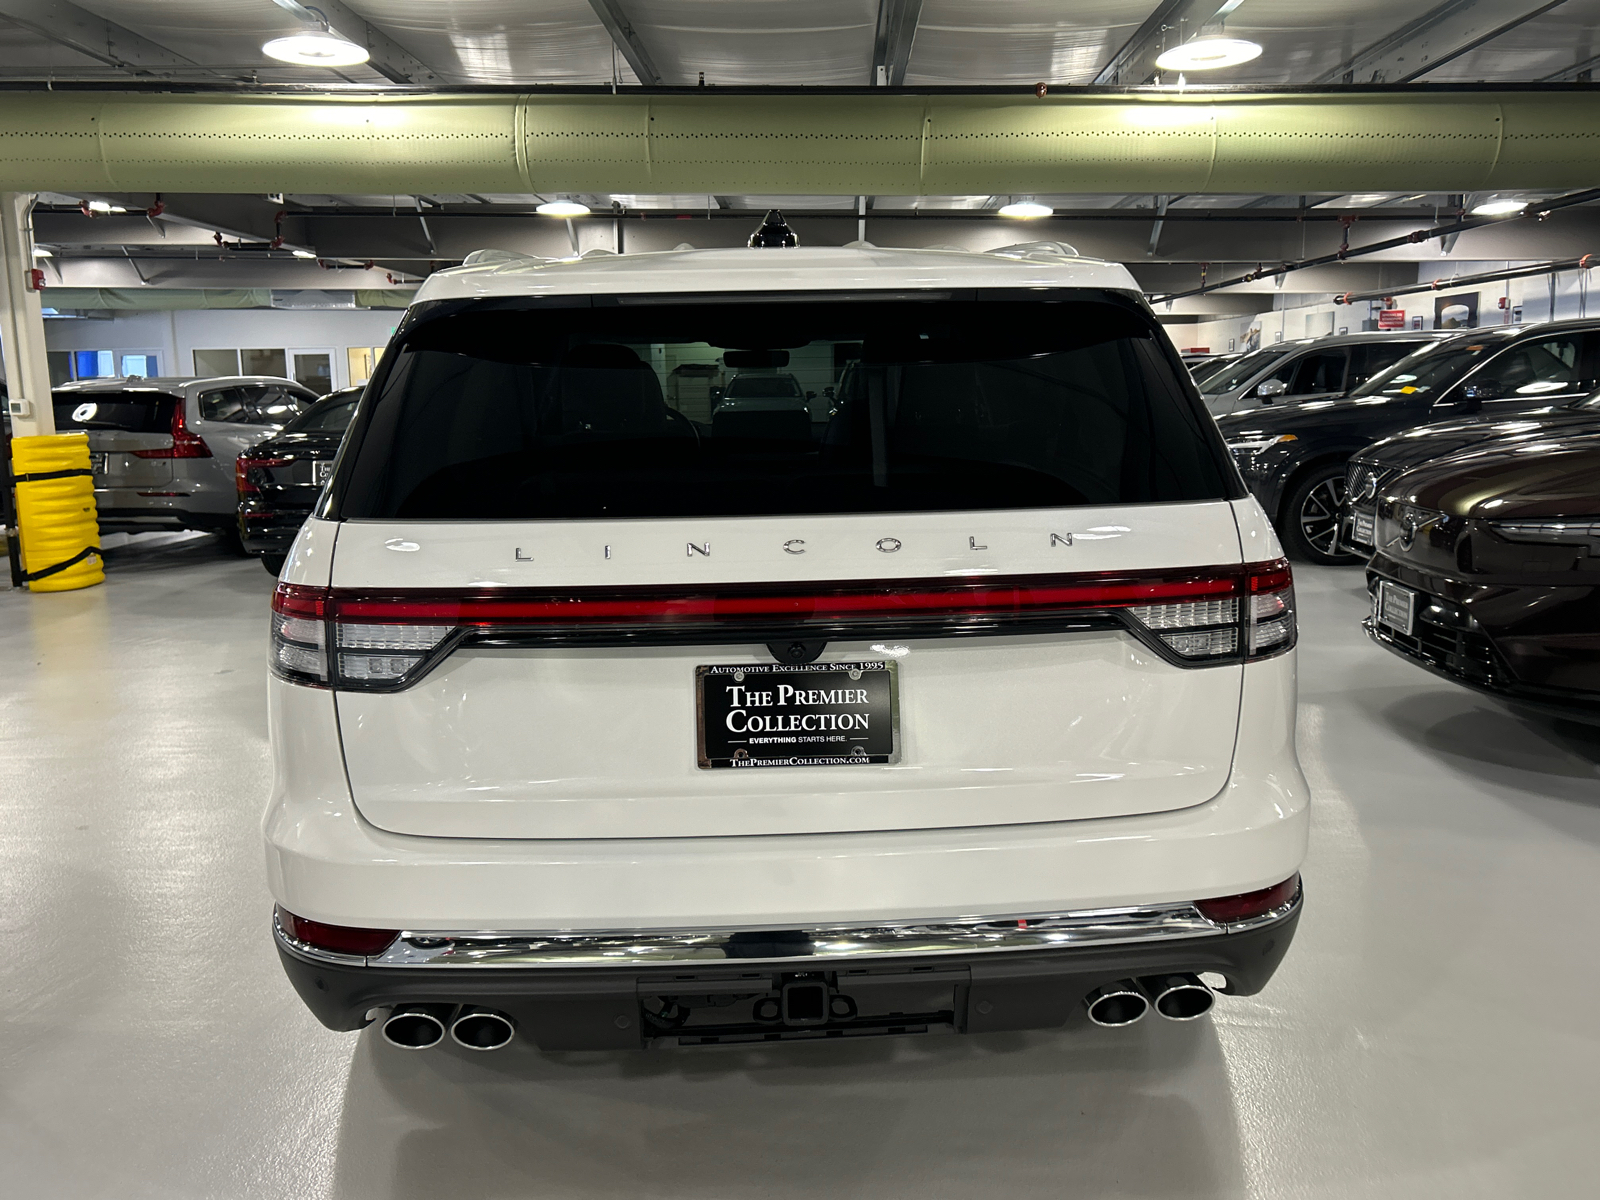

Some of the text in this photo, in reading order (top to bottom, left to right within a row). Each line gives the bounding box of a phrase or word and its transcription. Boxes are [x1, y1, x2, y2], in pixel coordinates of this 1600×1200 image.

[515, 532, 1073, 562] LINCOLN
[710, 661, 884, 674] AUTOMOTIVE EXCELLENCE SINCE 1995
[726, 684, 869, 707] THE PREMIER
[726, 709, 870, 733] COLLECTION
[749, 736, 797, 744] EVERYTHING
